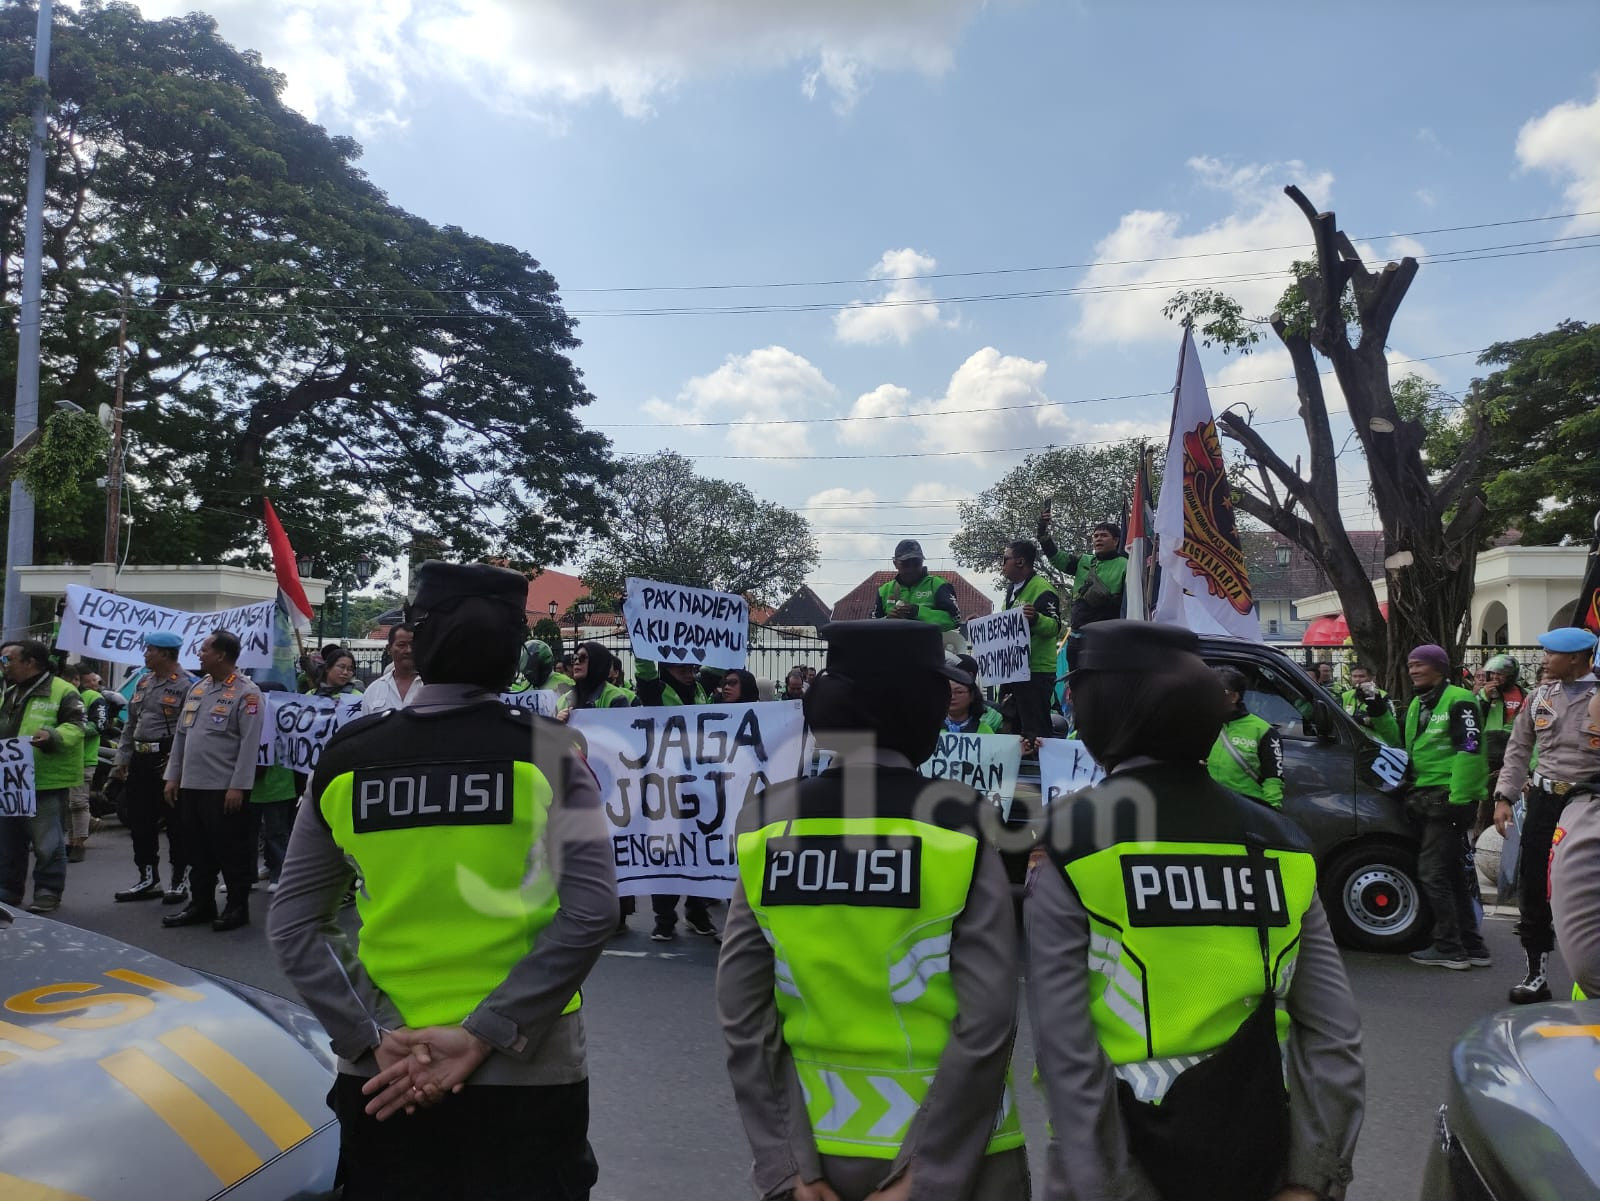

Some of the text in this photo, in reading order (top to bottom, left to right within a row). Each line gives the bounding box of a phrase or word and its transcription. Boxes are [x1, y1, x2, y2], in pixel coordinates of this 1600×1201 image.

[1182, 539, 1243, 600] YOGYAKARTA
[643, 587, 743, 624] PAK NADIEM
[987, 612, 1027, 641] BERSAMA
[632, 617, 743, 651] AKU PADAMU
[618, 708, 769, 770] JAGA
[360, 772, 504, 820] POLISI
[612, 831, 698, 869] ENGAN
[769, 849, 912, 894] POLISI
[1131, 864, 1281, 912] POLISI
